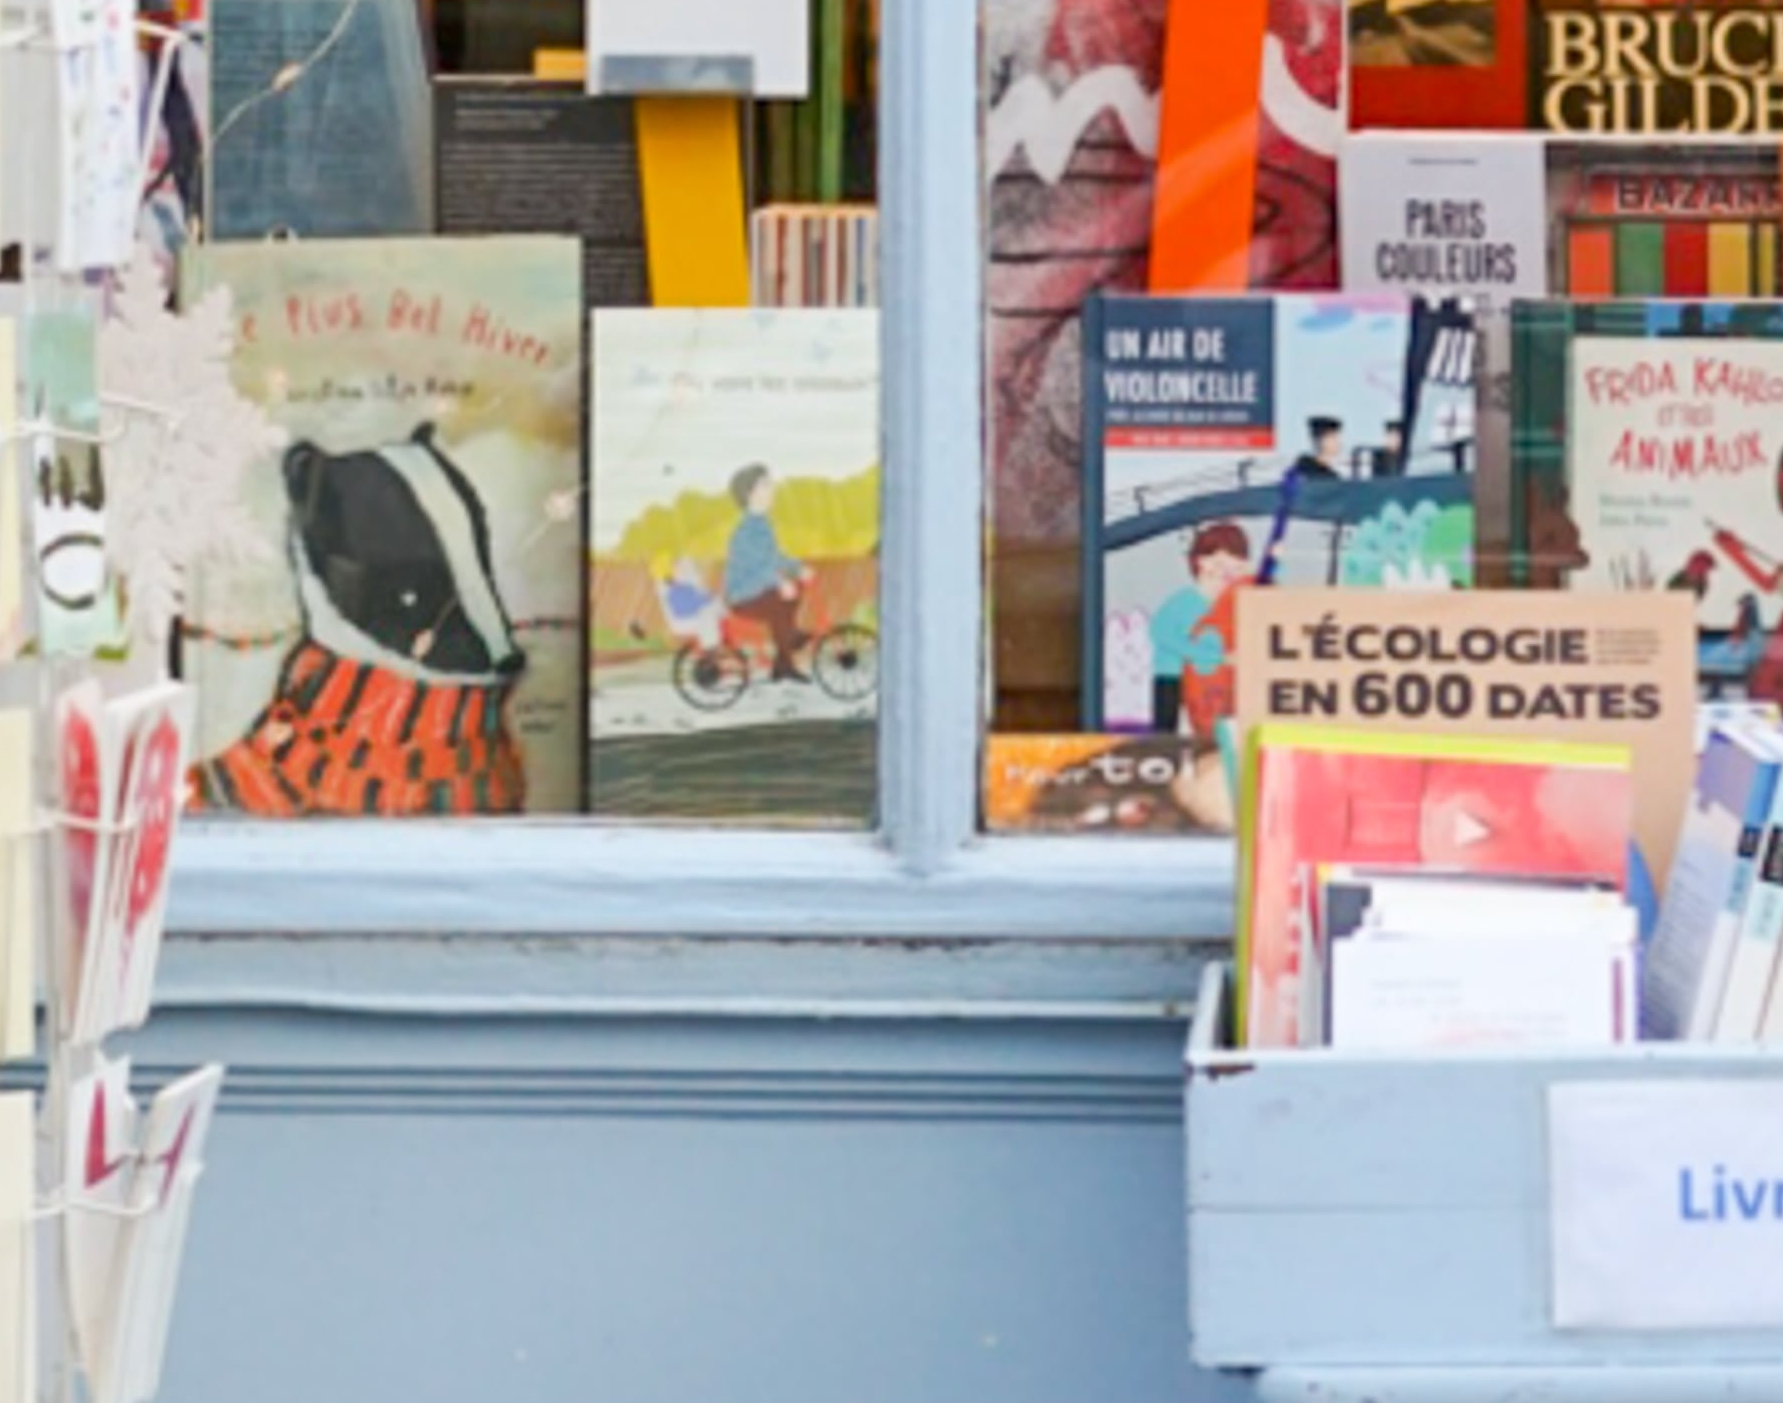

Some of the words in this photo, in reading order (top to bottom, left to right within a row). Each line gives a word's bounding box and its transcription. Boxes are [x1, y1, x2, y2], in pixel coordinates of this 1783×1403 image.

[1405, 198, 1486, 240] PARIS
[1375, 242, 1518, 284] COULEURS
[284, 293, 363, 338] Plus
[387, 287, 441, 338] Bel
[463, 301, 549, 364] Hiver
[1106, 327, 1141, 360] UN
[1148, 327, 1186, 360] AIR
[1192, 327, 1226, 361] DE
[1103, 370, 1259, 403] VIOLONCELLE
[1584, 360, 1677, 405] FRIDA
[1609, 429, 1766, 480] ANIMAUX
[1268, 612, 1589, 665] L'ÉCOLOGIE
[1268, 681, 1338, 716] EN
[1351, 672, 1474, 718] 600
[1487, 684, 1662, 721] DATES
